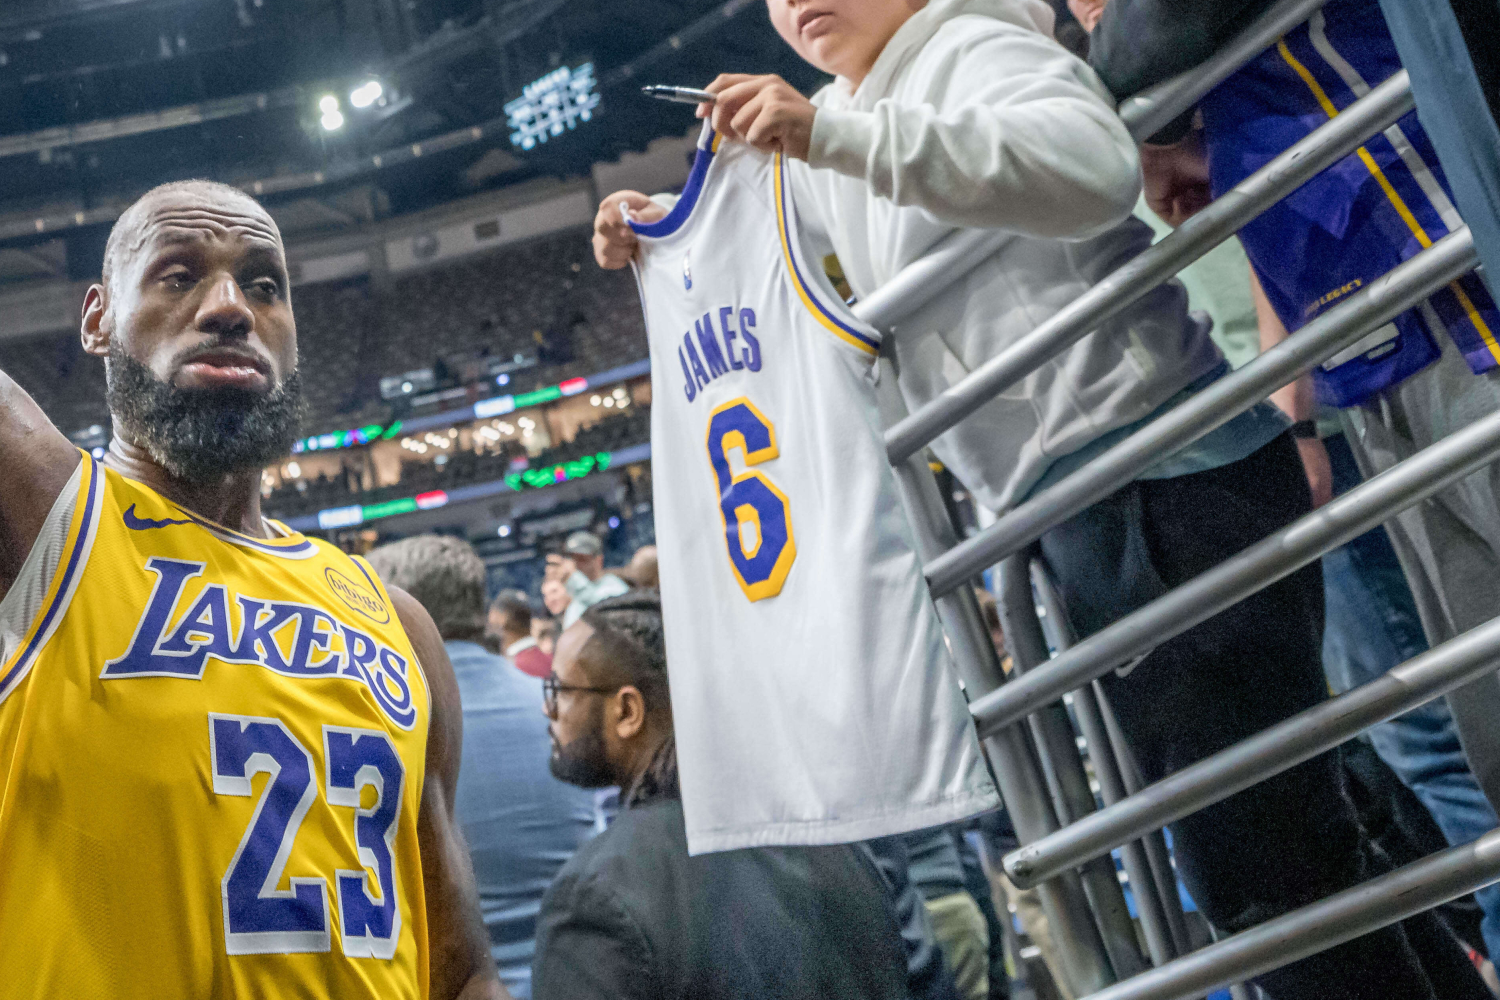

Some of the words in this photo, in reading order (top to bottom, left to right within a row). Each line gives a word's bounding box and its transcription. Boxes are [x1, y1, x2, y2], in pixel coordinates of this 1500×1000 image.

[677, 305, 764, 403] JAMES
[704, 395, 798, 604] 6
[100, 556, 418, 731] LAKERS
[329, 573, 385, 613] bibigo
[207, 712, 408, 961] 23
